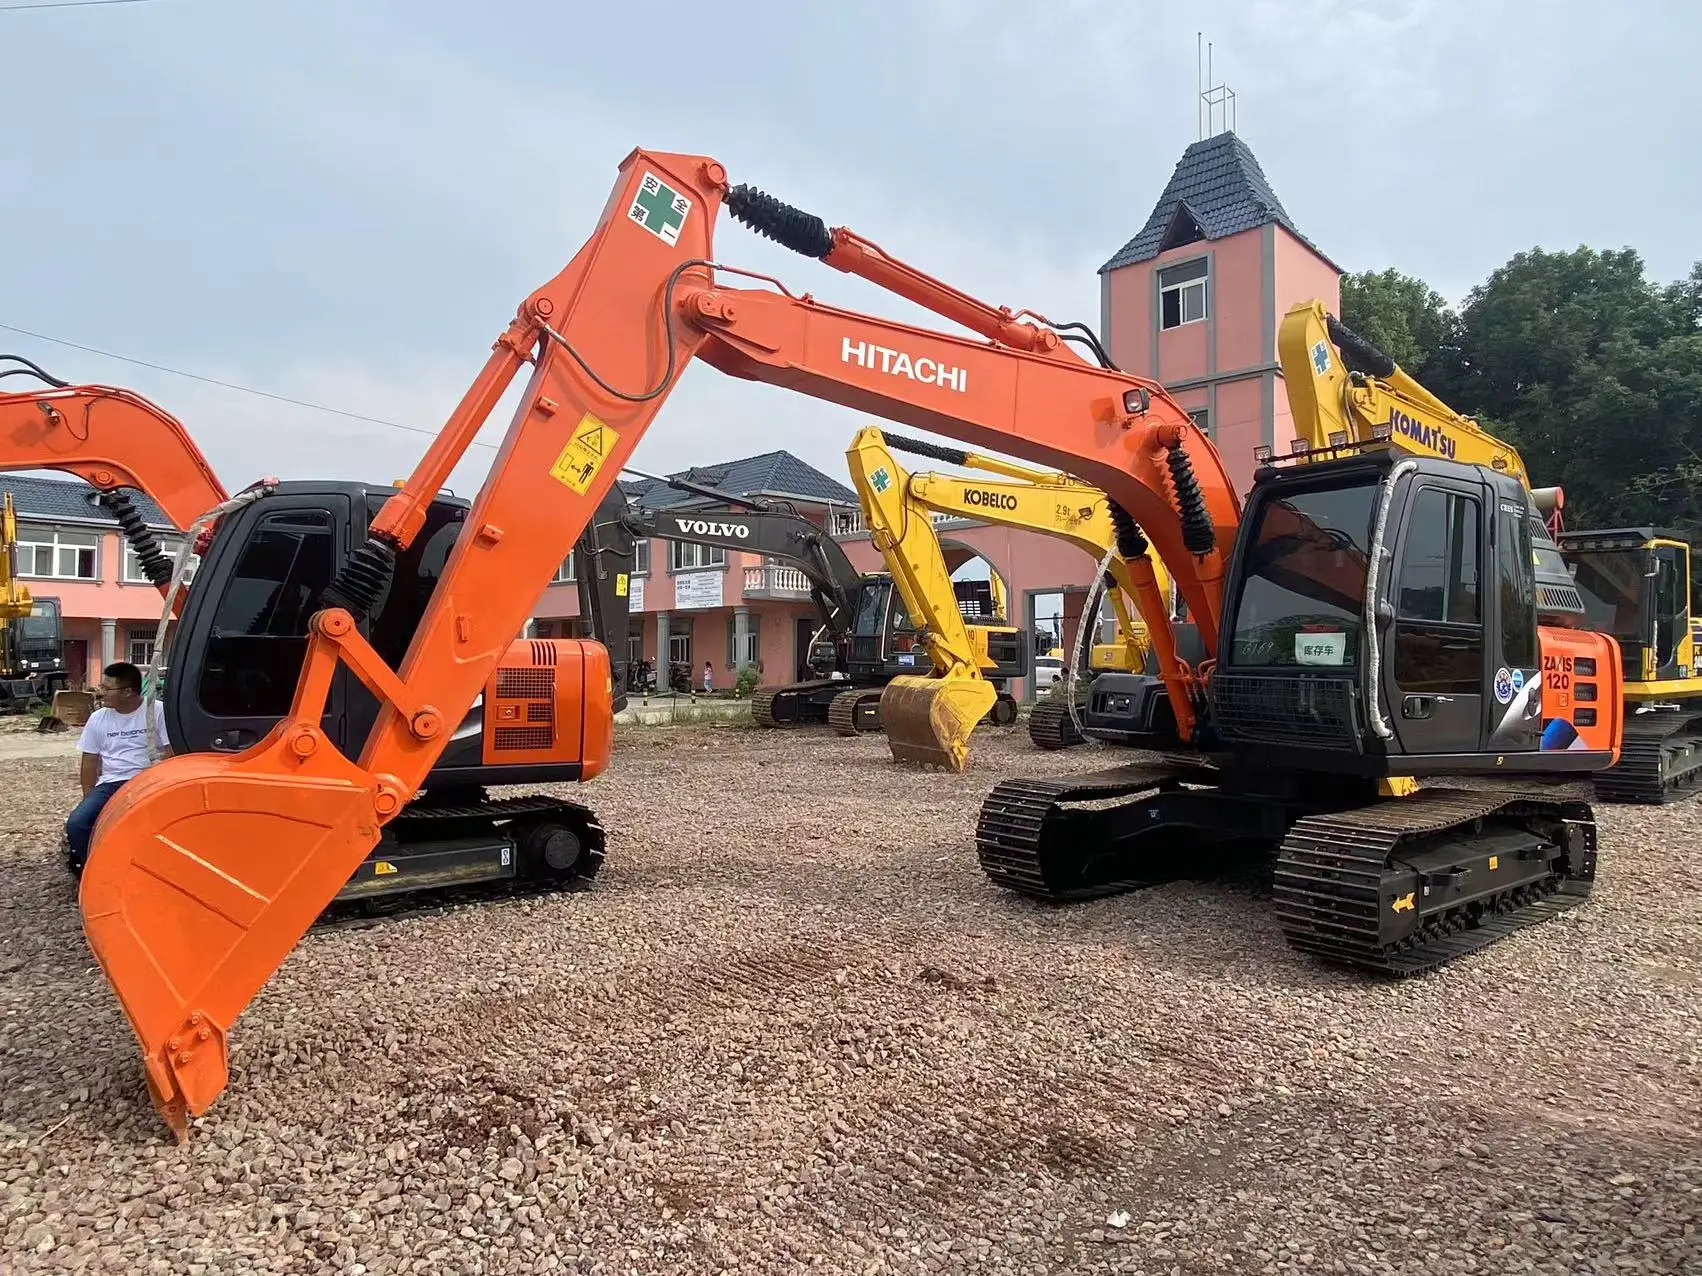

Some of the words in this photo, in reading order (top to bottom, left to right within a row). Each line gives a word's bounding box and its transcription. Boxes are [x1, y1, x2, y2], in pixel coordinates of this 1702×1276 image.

[841, 336, 967, 393] HITACHI
[1389, 406, 1456, 459] KOMATSU
[963, 488, 1018, 511] KOBELCO
[675, 518, 750, 539] VOLVO
[1303, 645, 1335, 656] 库存车
[1546, 673, 1570, 690] 120
